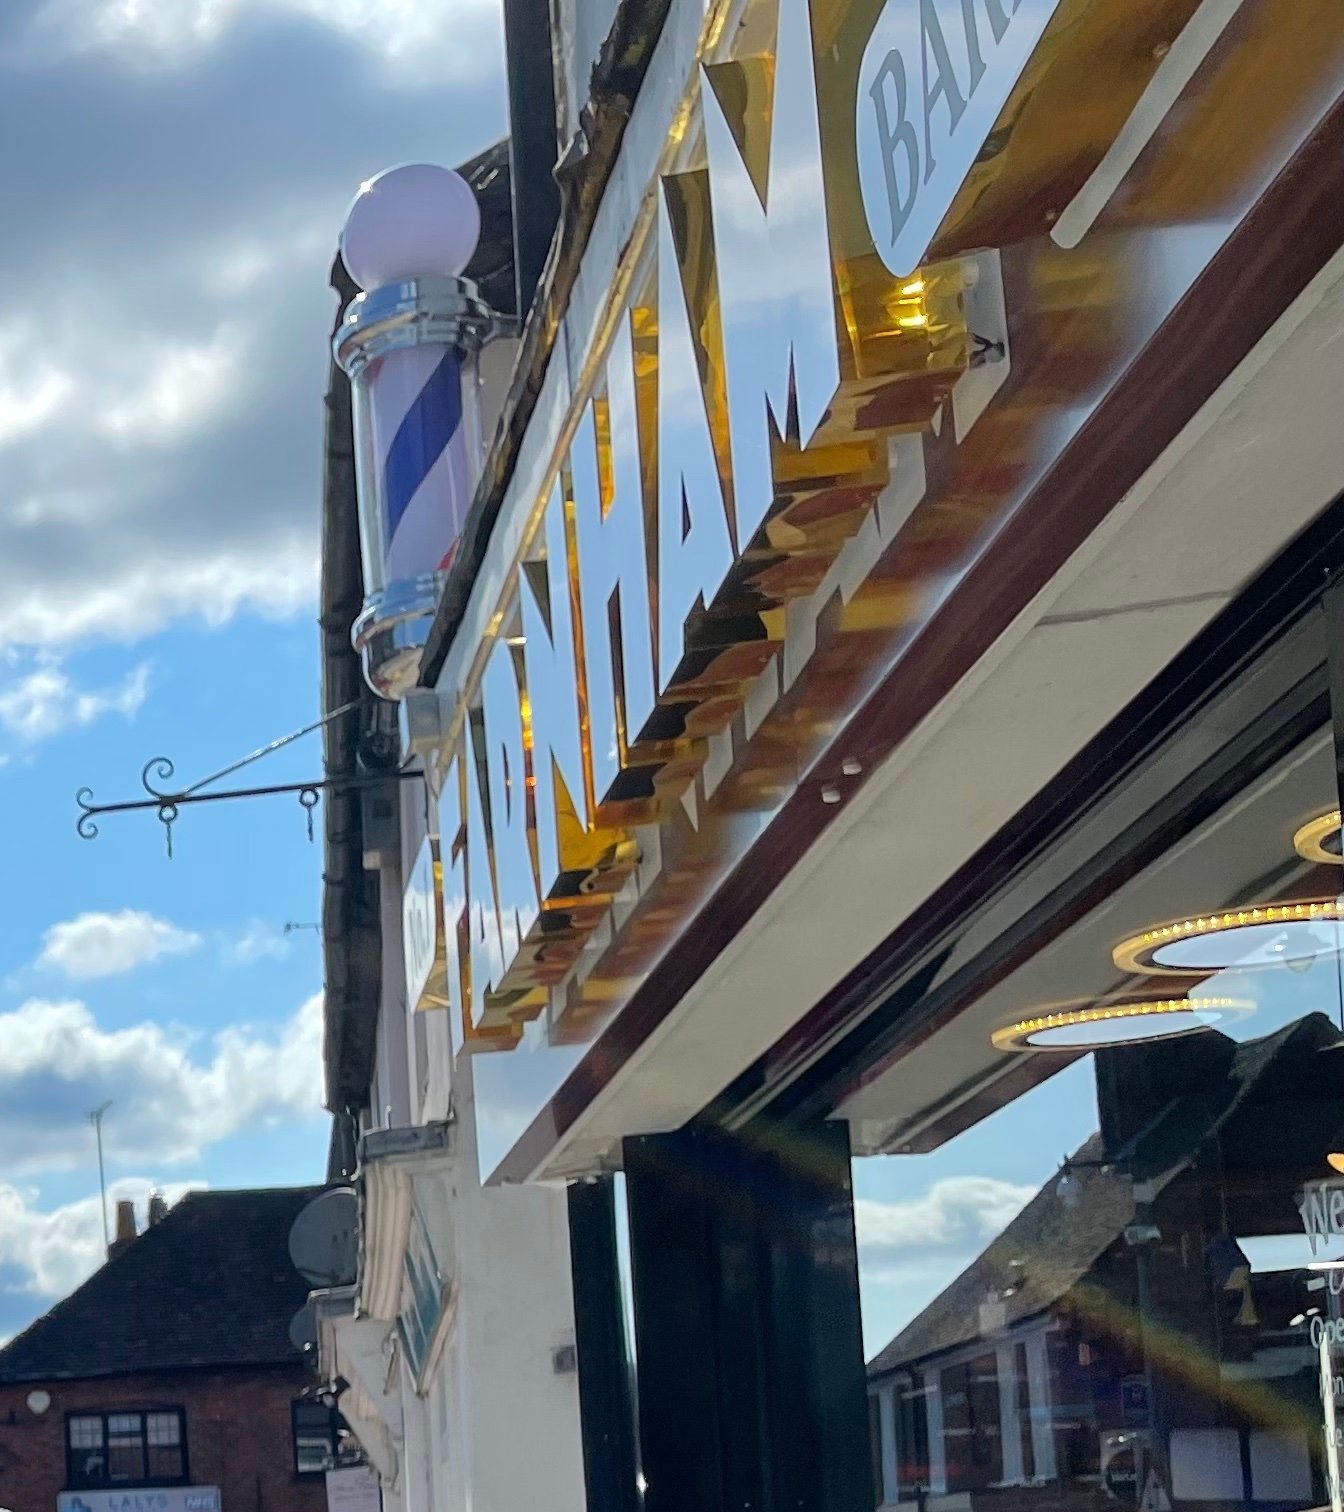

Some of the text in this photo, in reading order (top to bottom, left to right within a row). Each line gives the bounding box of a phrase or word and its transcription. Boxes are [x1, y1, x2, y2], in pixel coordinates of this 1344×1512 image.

[438, 0, 841, 1071] FARNHAM
[869, 0, 1023, 248] BA
[185, 1495, 216, 1511] NHS
